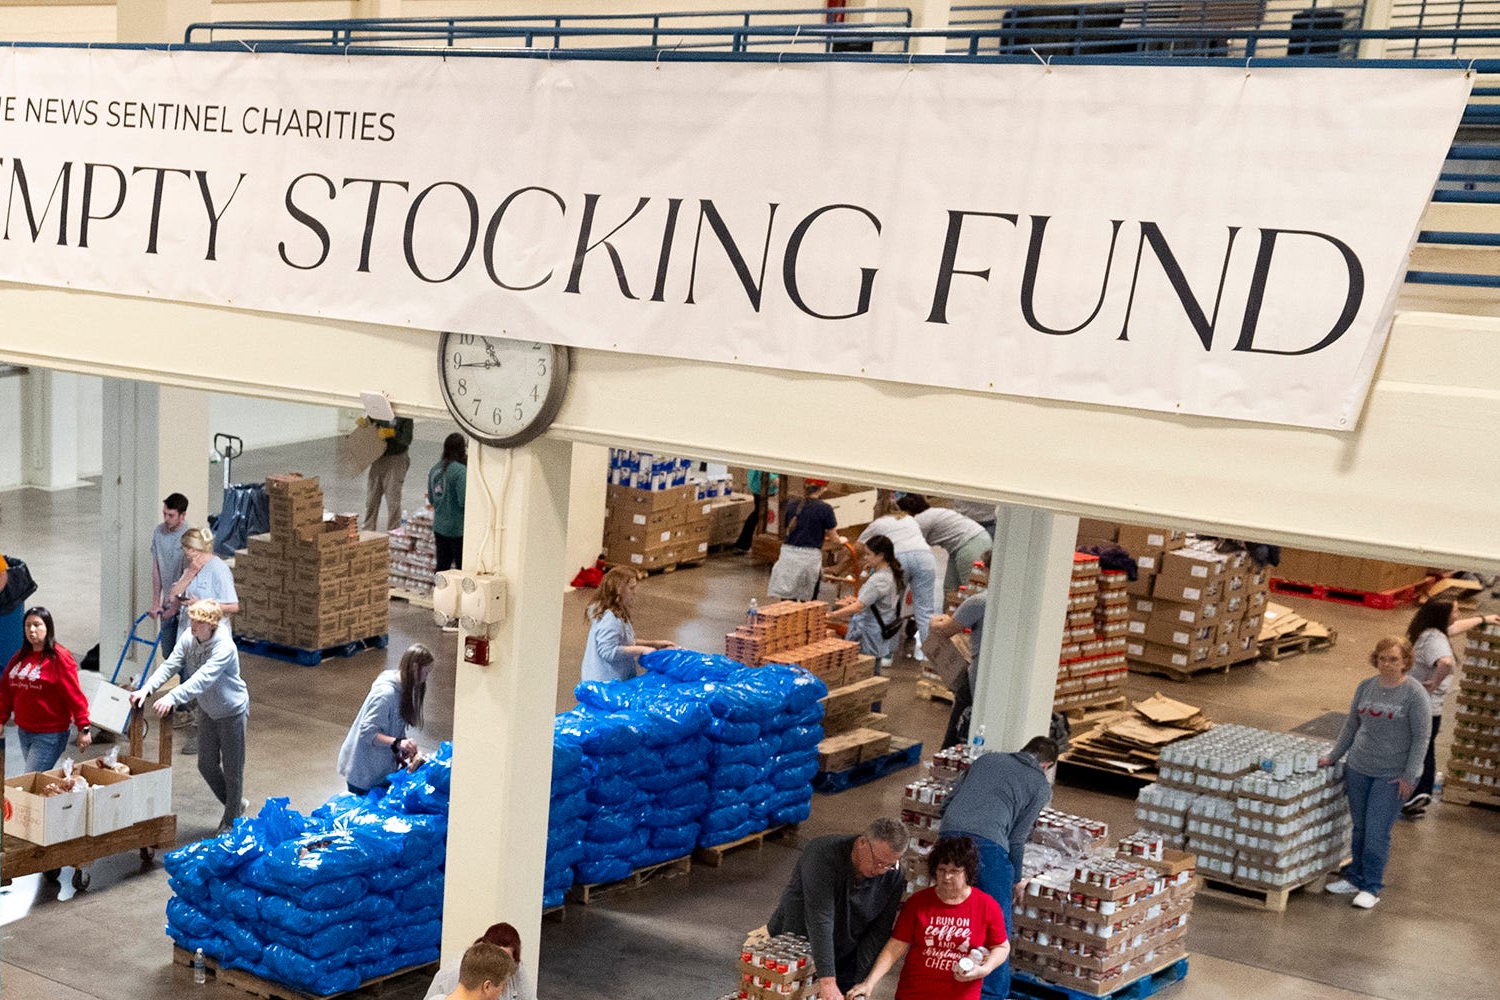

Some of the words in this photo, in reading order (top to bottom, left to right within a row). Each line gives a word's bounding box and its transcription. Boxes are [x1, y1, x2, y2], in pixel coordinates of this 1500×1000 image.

[25, 97, 98, 126] NEWS
[107, 101, 232, 133] SENTINEL
[243, 106, 395, 142] CHARITIES
[278, 172, 882, 320] STOCKING
[925, 209, 1365, 356] FUND
[454, 352, 462, 369] 9
[537, 358, 547, 376] 3
[458, 379, 467, 396] 8
[529, 384, 539, 402] 4
[473, 399, 481, 416] 7
[514, 403, 523, 421] 5
[493, 408, 501, 425] 6
[930, 917, 934, 925] I
[936, 916, 954, 925] RUN
[956, 917, 970, 927] ON
[938, 941, 956, 949] AND
